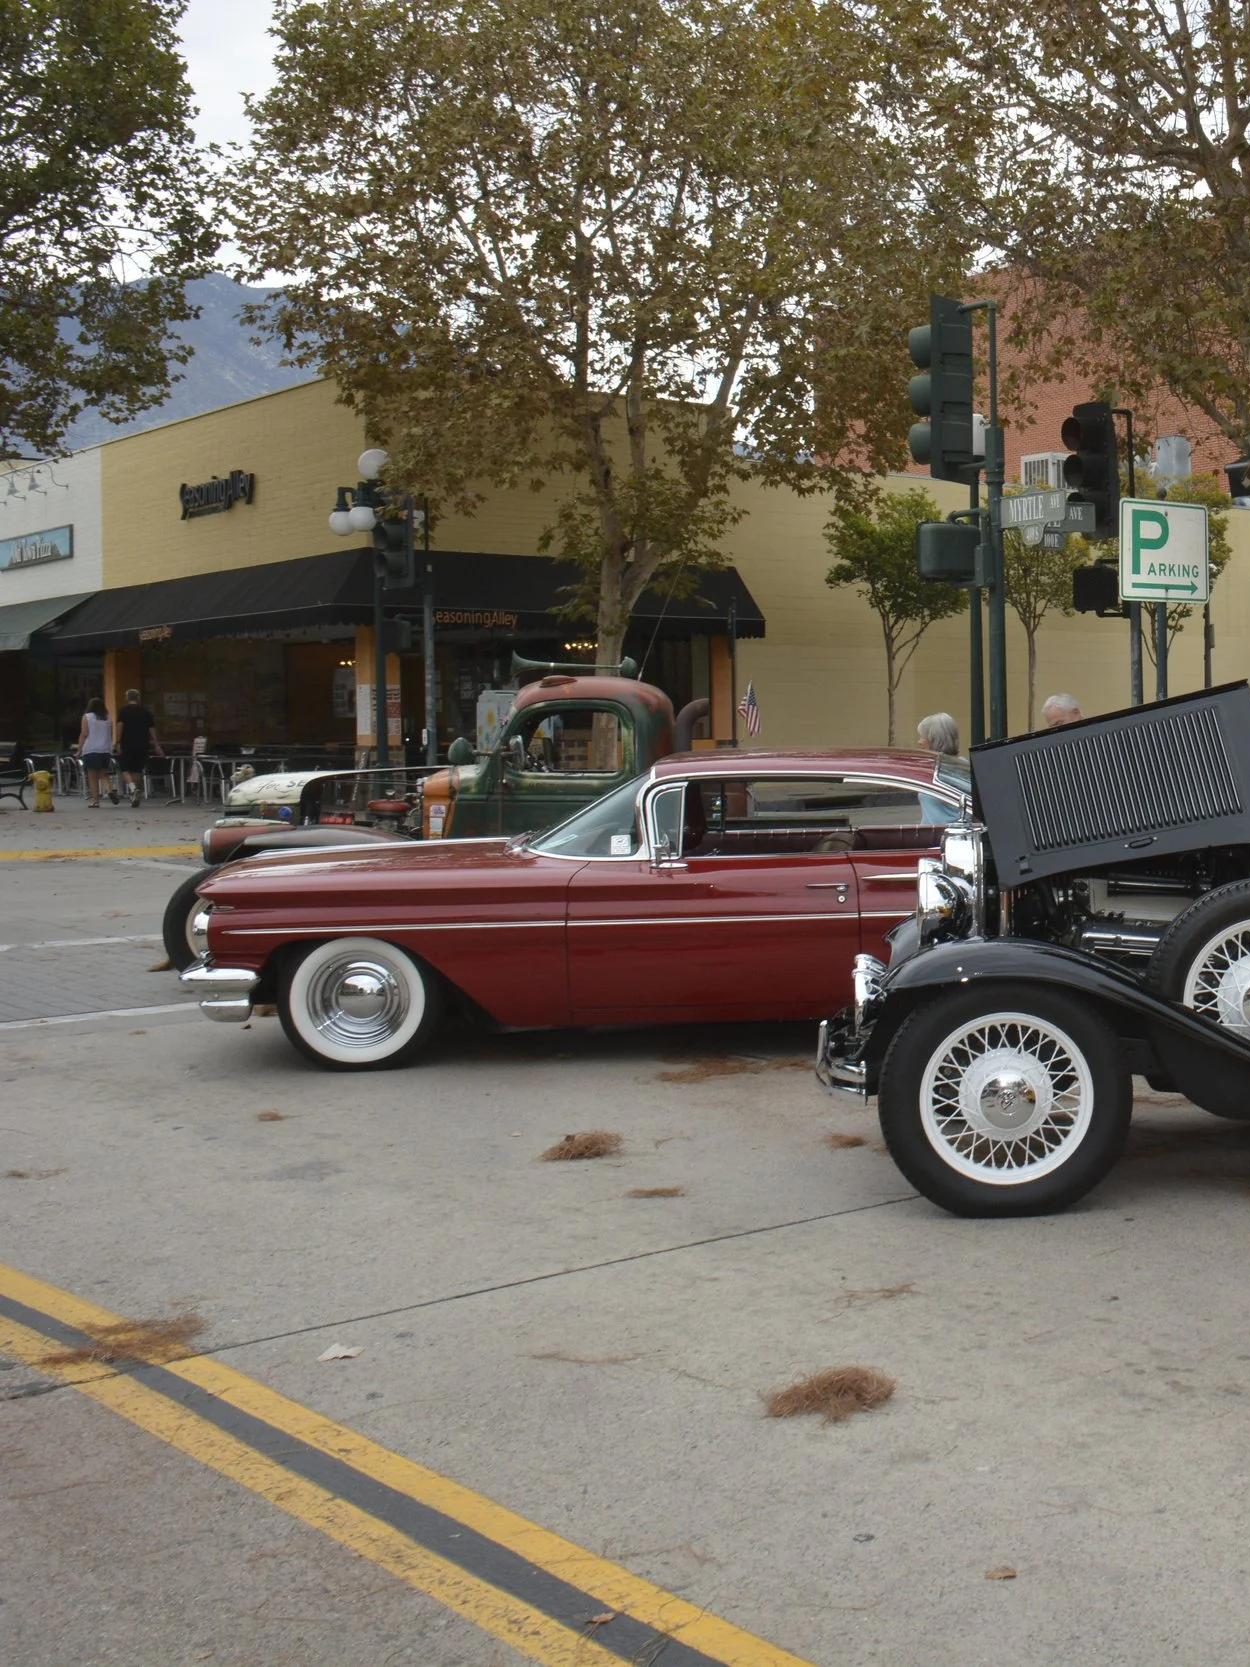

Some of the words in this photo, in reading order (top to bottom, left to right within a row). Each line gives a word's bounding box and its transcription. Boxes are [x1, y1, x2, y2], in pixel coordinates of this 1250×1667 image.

[1009, 495, 1044, 523] MYRTLE
[1050, 493, 1061, 509] AVE
[1068, 506, 1083, 520] AVE
